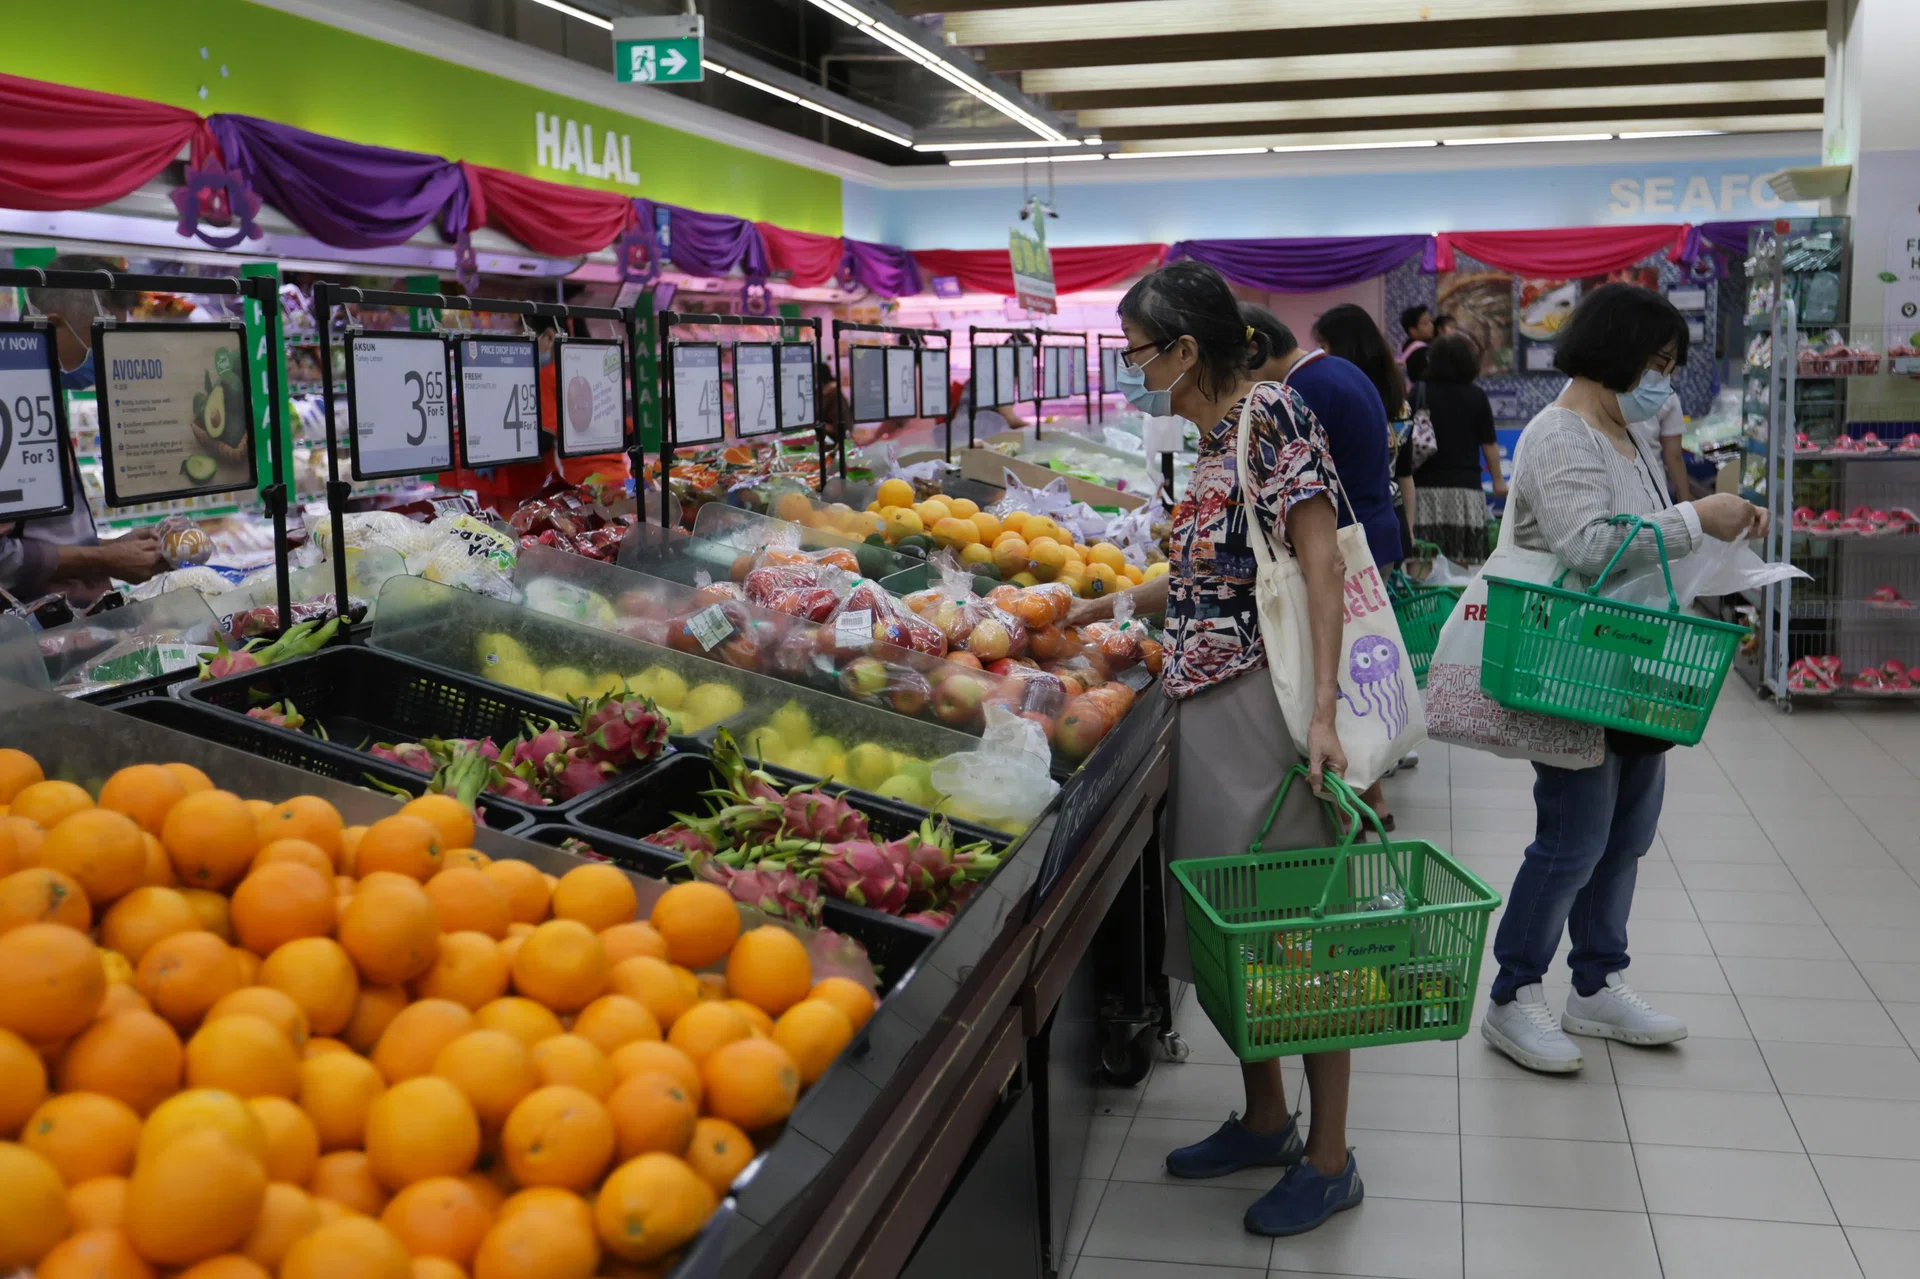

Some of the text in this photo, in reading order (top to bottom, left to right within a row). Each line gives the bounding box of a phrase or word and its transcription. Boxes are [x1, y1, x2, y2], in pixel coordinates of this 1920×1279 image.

[536, 111, 640, 185] HALAL
[1609, 172, 1820, 215] SEAFO
[9, 338, 38, 350] NOW
[112, 359, 163, 380] AVOCADO
[635, 317, 653, 428] HALAL
[15, 396, 53, 438] 95
[404, 370, 443, 446] 3 65
[427, 406, 445, 417] For 5
[503, 383, 524, 452] 4
[521, 384, 537, 411] 95
[698, 379, 711, 434] 4
[756, 375, 767, 426] 2
[797, 374, 806, 422] 5
[523, 421, 532, 431] For
[22, 448, 54, 465] For 3
[1611, 628, 1653, 646] FairPrice
[1347, 943, 1396, 957] FairPrice
